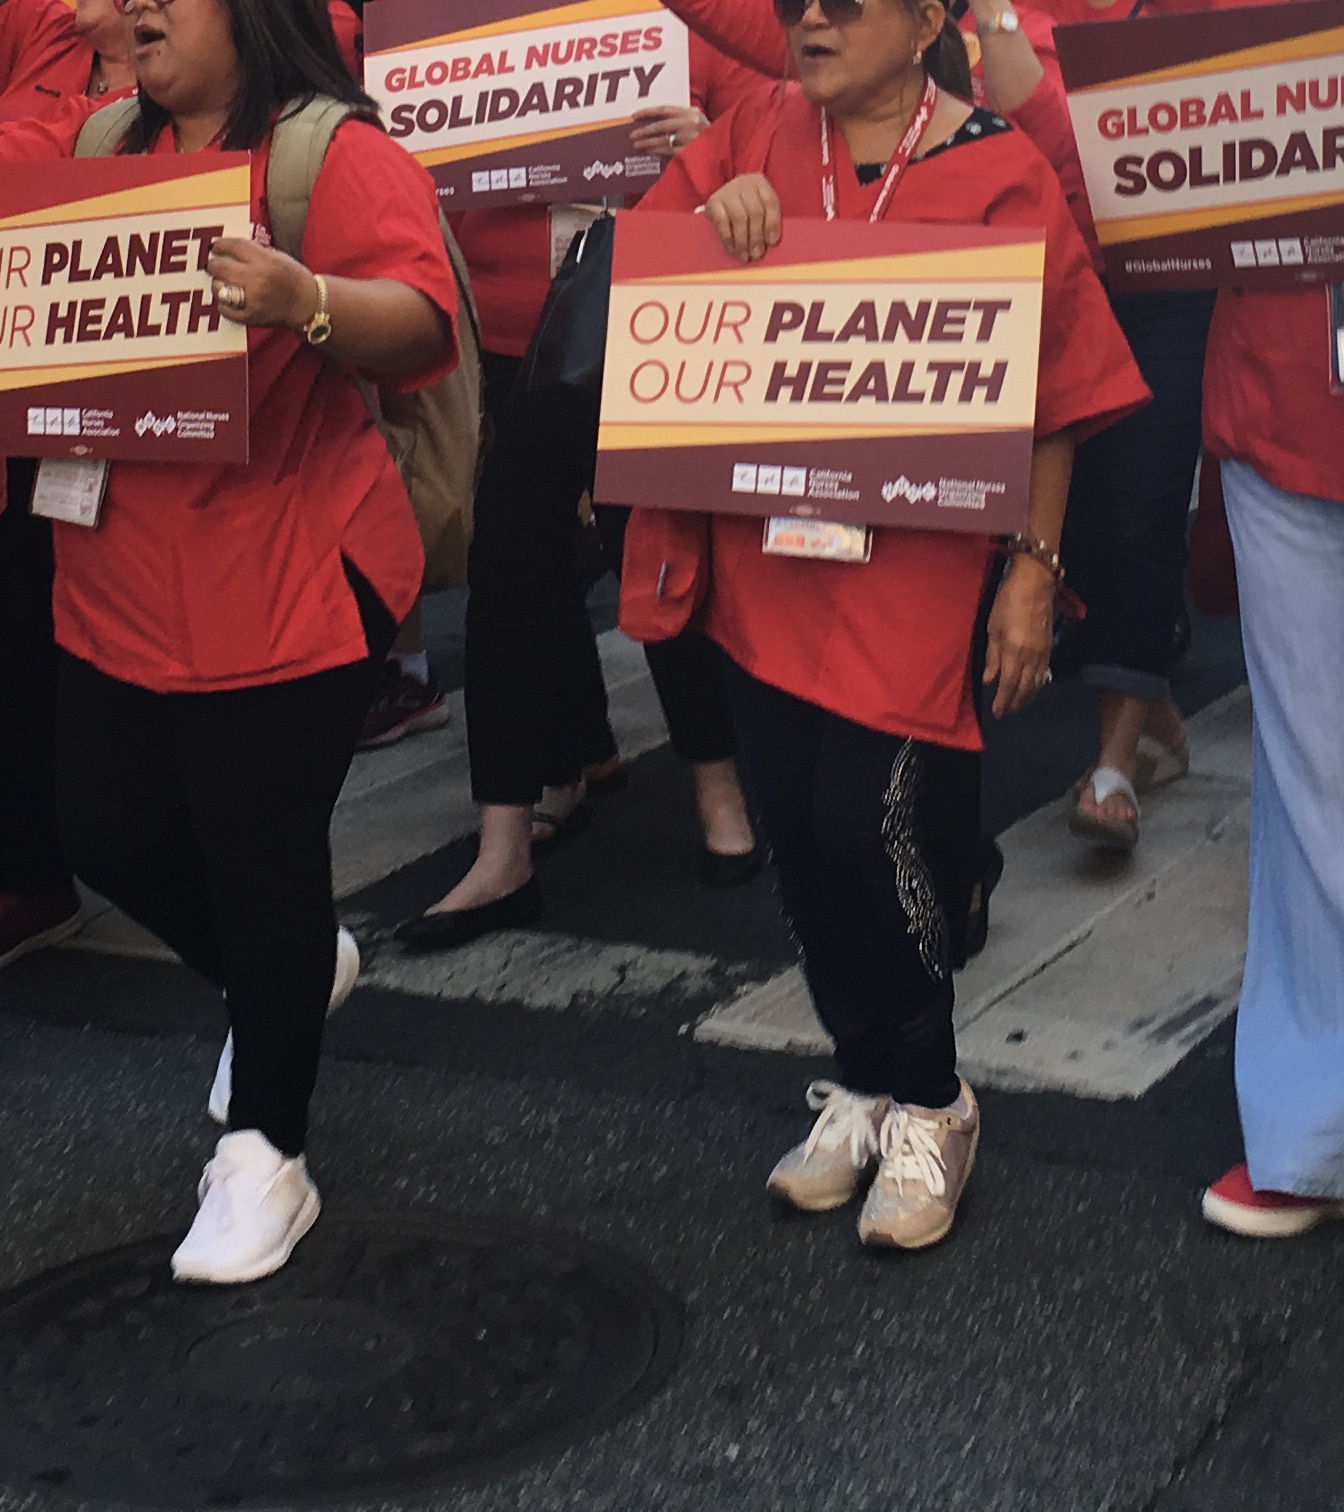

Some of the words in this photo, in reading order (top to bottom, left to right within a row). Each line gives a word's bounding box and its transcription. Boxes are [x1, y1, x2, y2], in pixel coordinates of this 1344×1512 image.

[384, 50, 515, 93] GLOBAL
[524, 26, 663, 71] NURSES
[388, 62, 666, 139] SOLIDARITY
[1097, 89, 1264, 141] GLOBAL
[41, 225, 225, 286] PLANET
[44, 289, 222, 346] HEALTH
[629, 299, 752, 345] OUR
[763, 297, 1013, 345] PLANET
[629, 358, 753, 405] OUR
[764, 358, 1009, 406] HEALTH
